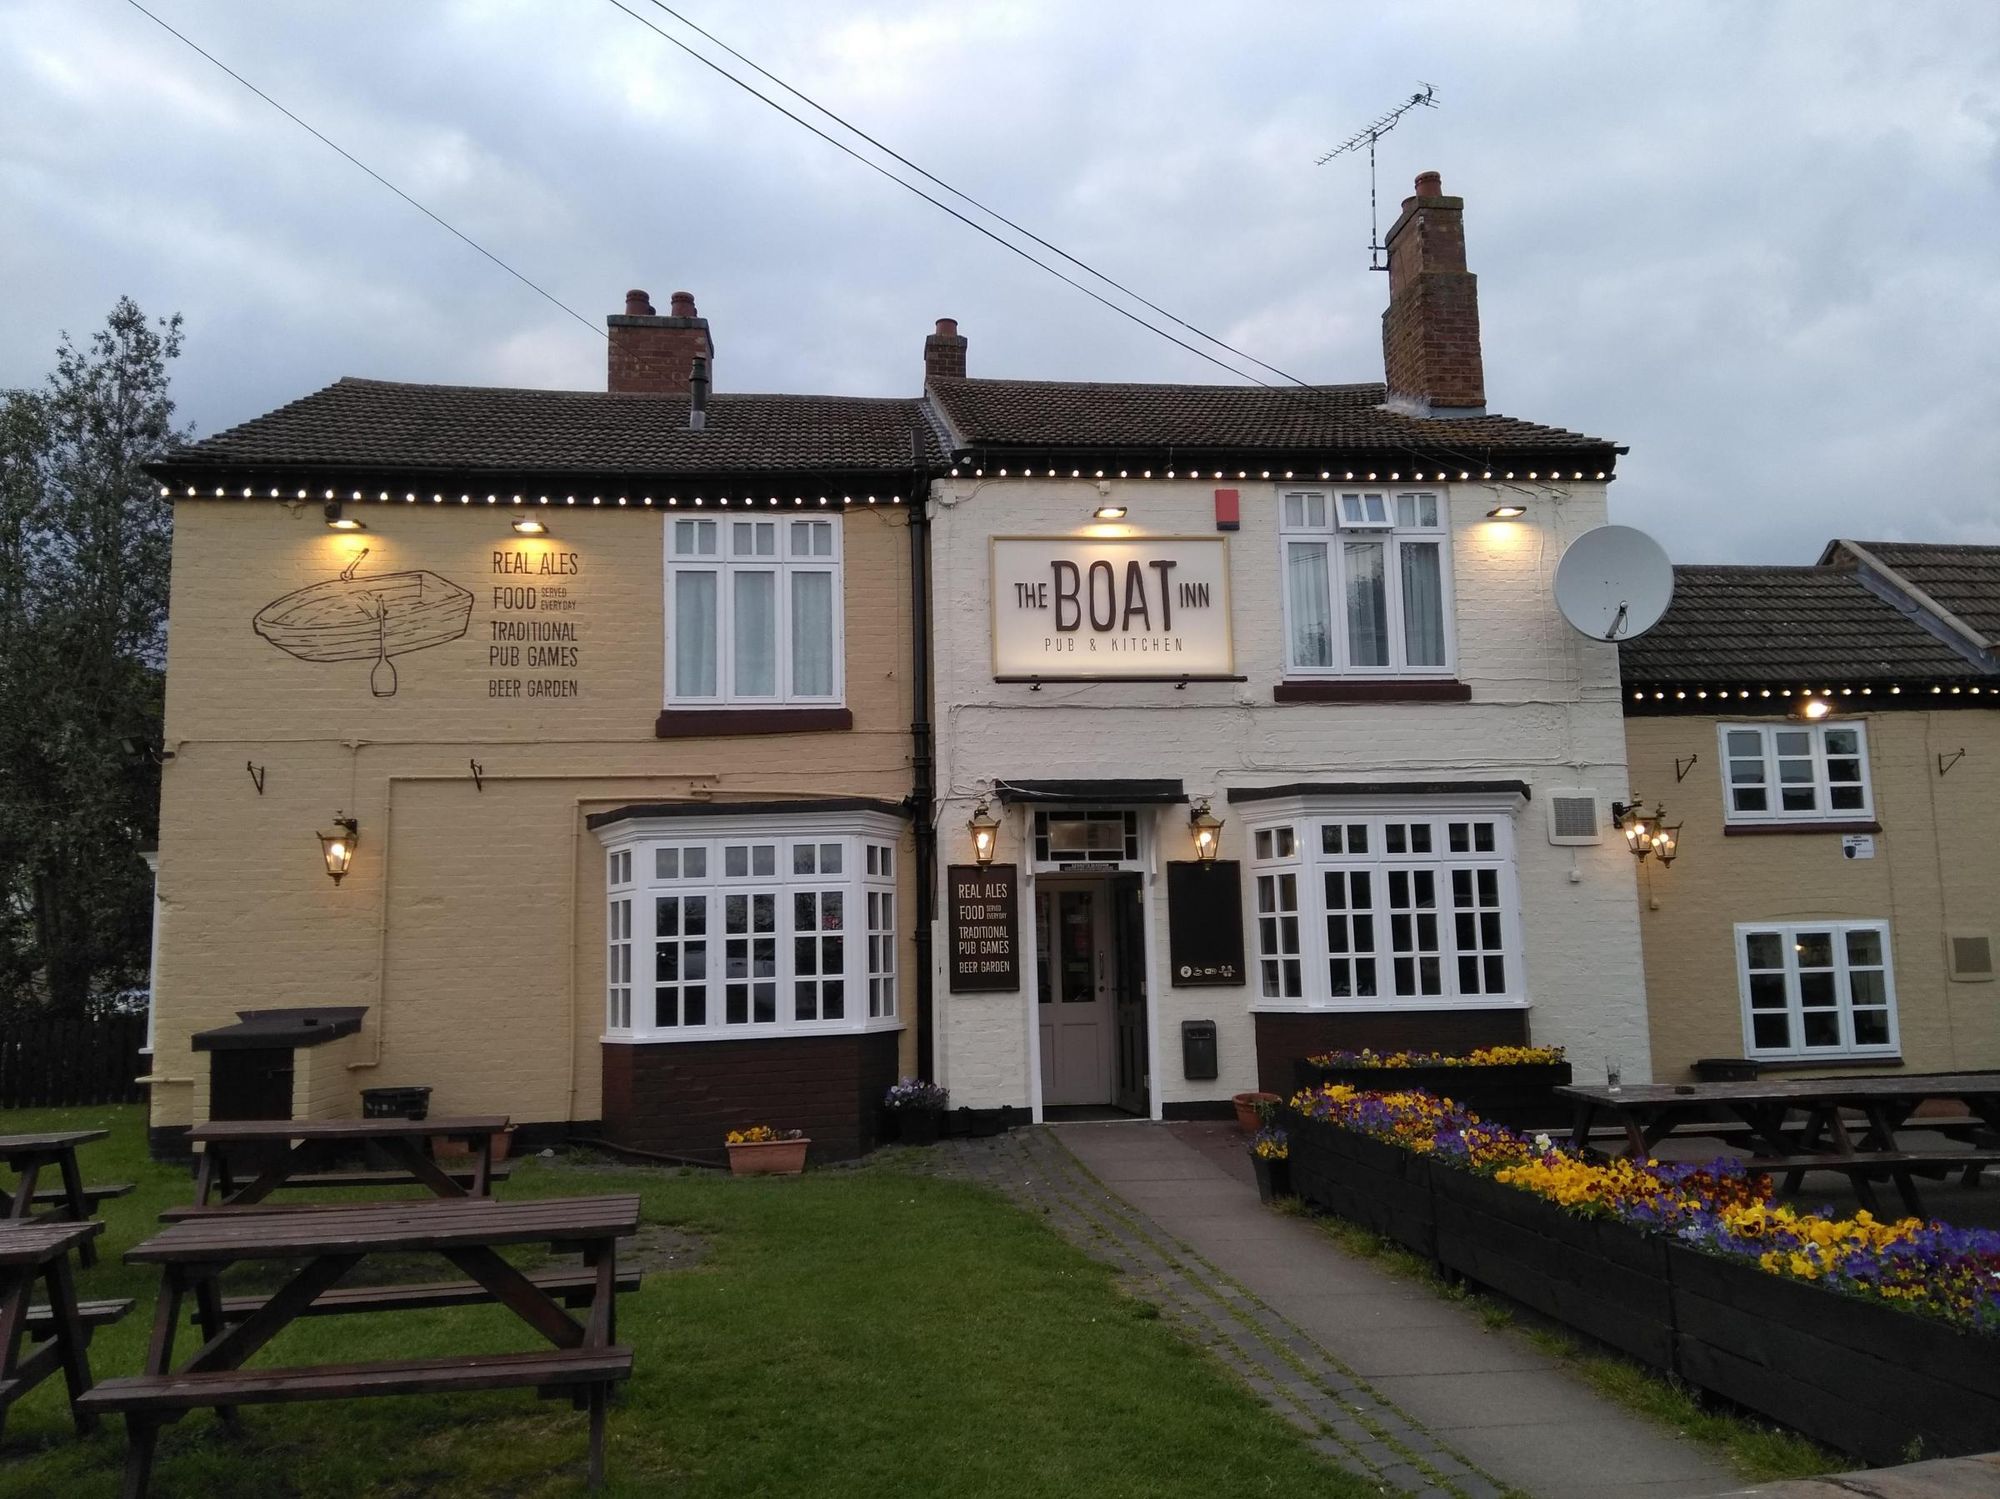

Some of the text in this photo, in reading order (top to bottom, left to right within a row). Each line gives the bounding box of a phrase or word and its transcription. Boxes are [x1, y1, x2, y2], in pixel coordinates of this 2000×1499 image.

[493, 551, 578, 575] REAL ALES
[494, 586, 536, 610] FOOD
[541, 587, 567, 598] SERVED
[1014, 560, 1210, 632] THE BOAT INN
[490, 620, 578, 641] TRADITIONAL
[1045, 638, 1183, 651] PUB & KITCHEN
[489, 645, 579, 667] PUB GAMES
[489, 679, 578, 698] BEER GARDEN
[958, 883, 1007, 898] REAL ALES
[959, 905, 985, 920] FOOD
[959, 926, 1009, 939] TRADITIONAL
[959, 941, 1009, 954] PUB GAMES
[959, 960, 1010, 973] BEER GARDEN
